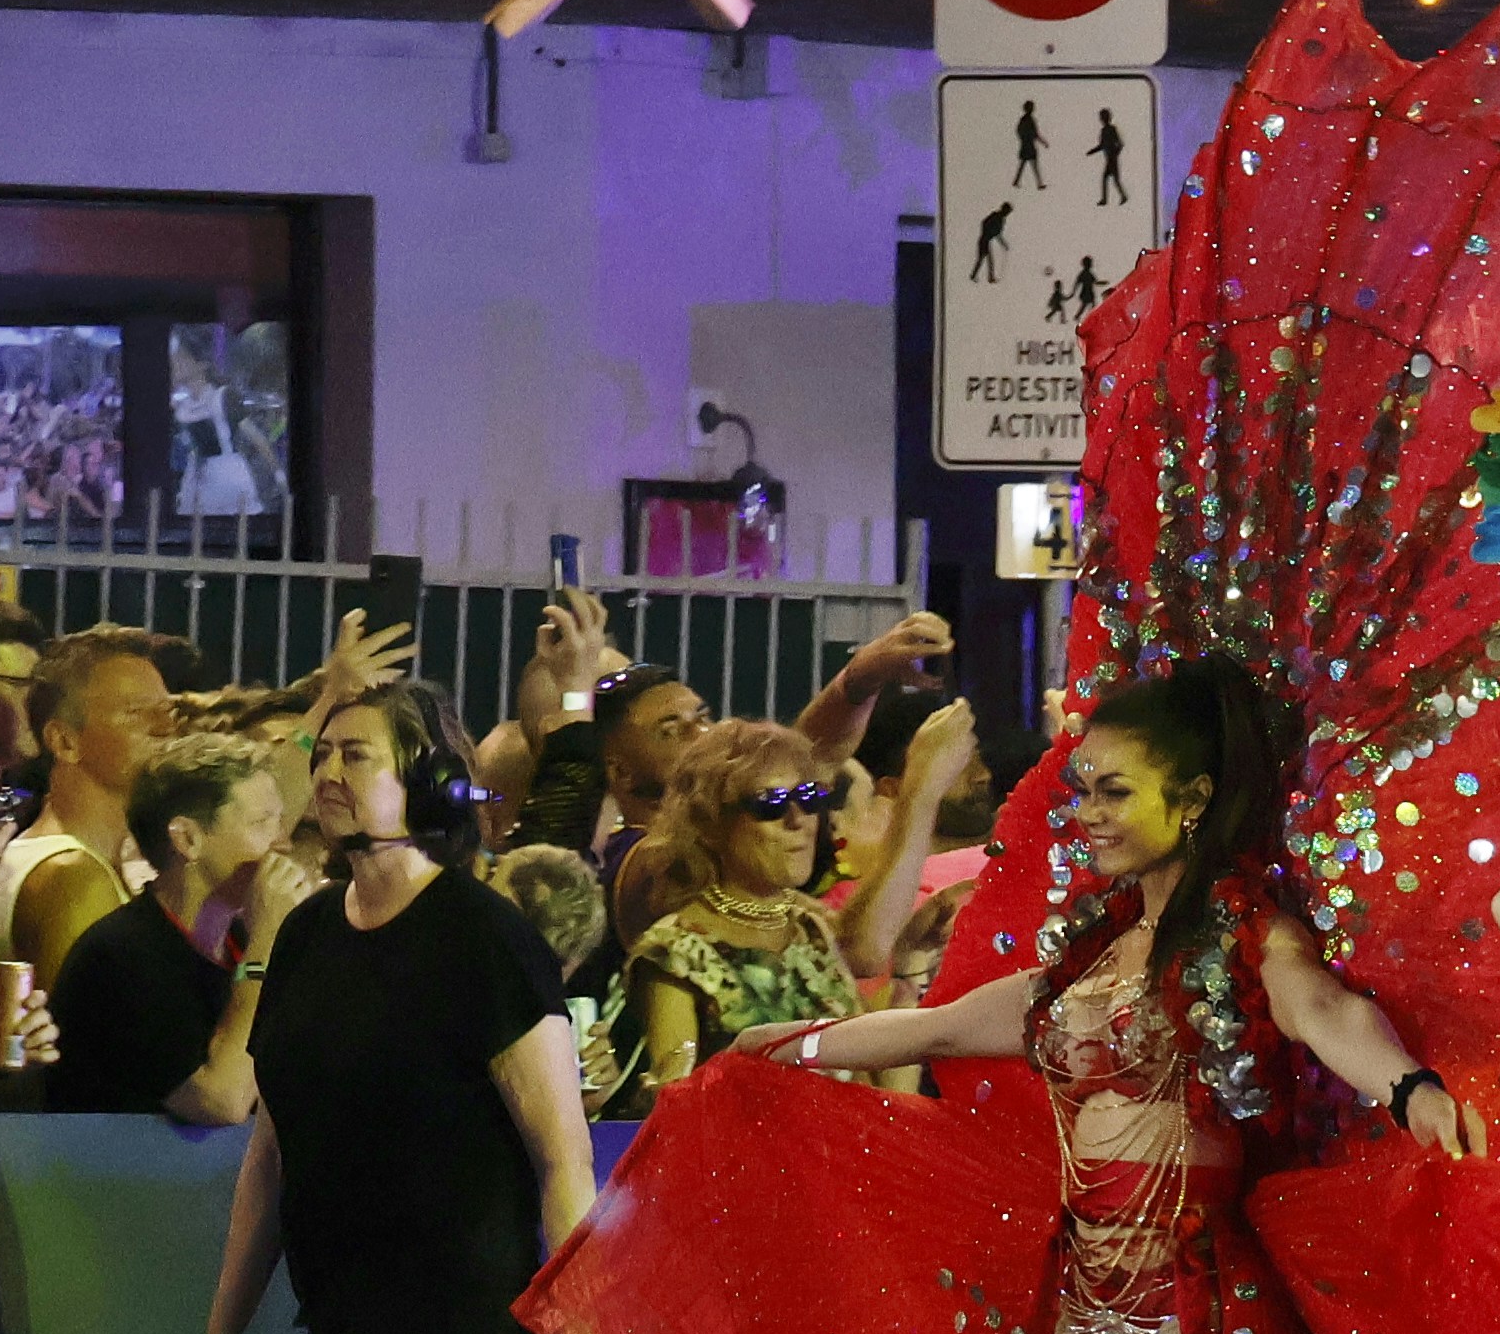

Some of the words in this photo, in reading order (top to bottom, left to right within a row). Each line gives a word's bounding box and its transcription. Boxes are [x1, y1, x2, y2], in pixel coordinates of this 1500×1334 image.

[1016, 340, 1074, 365] HIGH
[966, 377, 1080, 402] PEDESTR
[988, 414, 1081, 439] ACTIVIT
